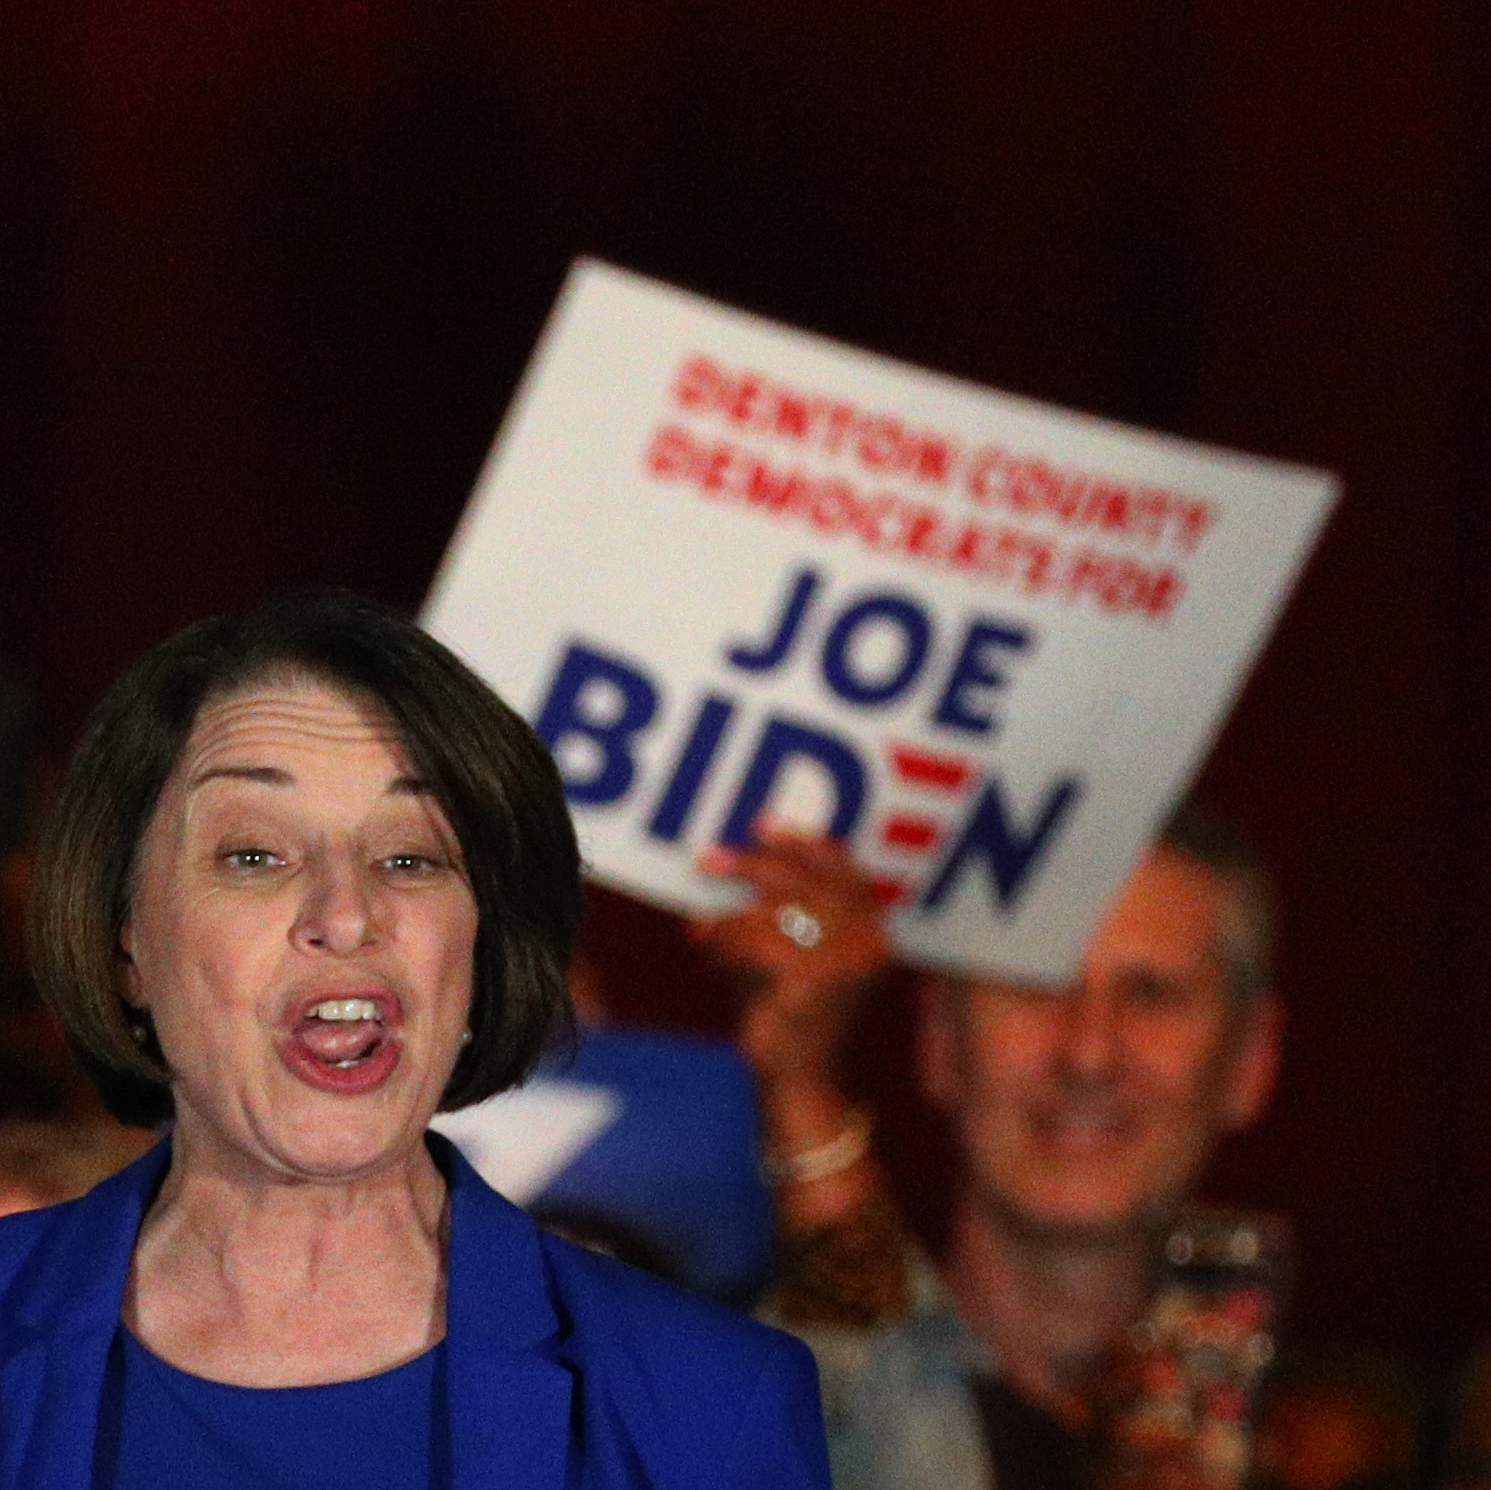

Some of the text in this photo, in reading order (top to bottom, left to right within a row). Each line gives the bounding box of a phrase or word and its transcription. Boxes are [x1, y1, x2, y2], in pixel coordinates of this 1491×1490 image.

[647, 424, 1185, 621] DEMOCRATS FOR
[673, 354, 1212, 557] DENTON COUNTY
[724, 562, 1031, 739] JOE
[533, 637, 1086, 914] BIDEN
